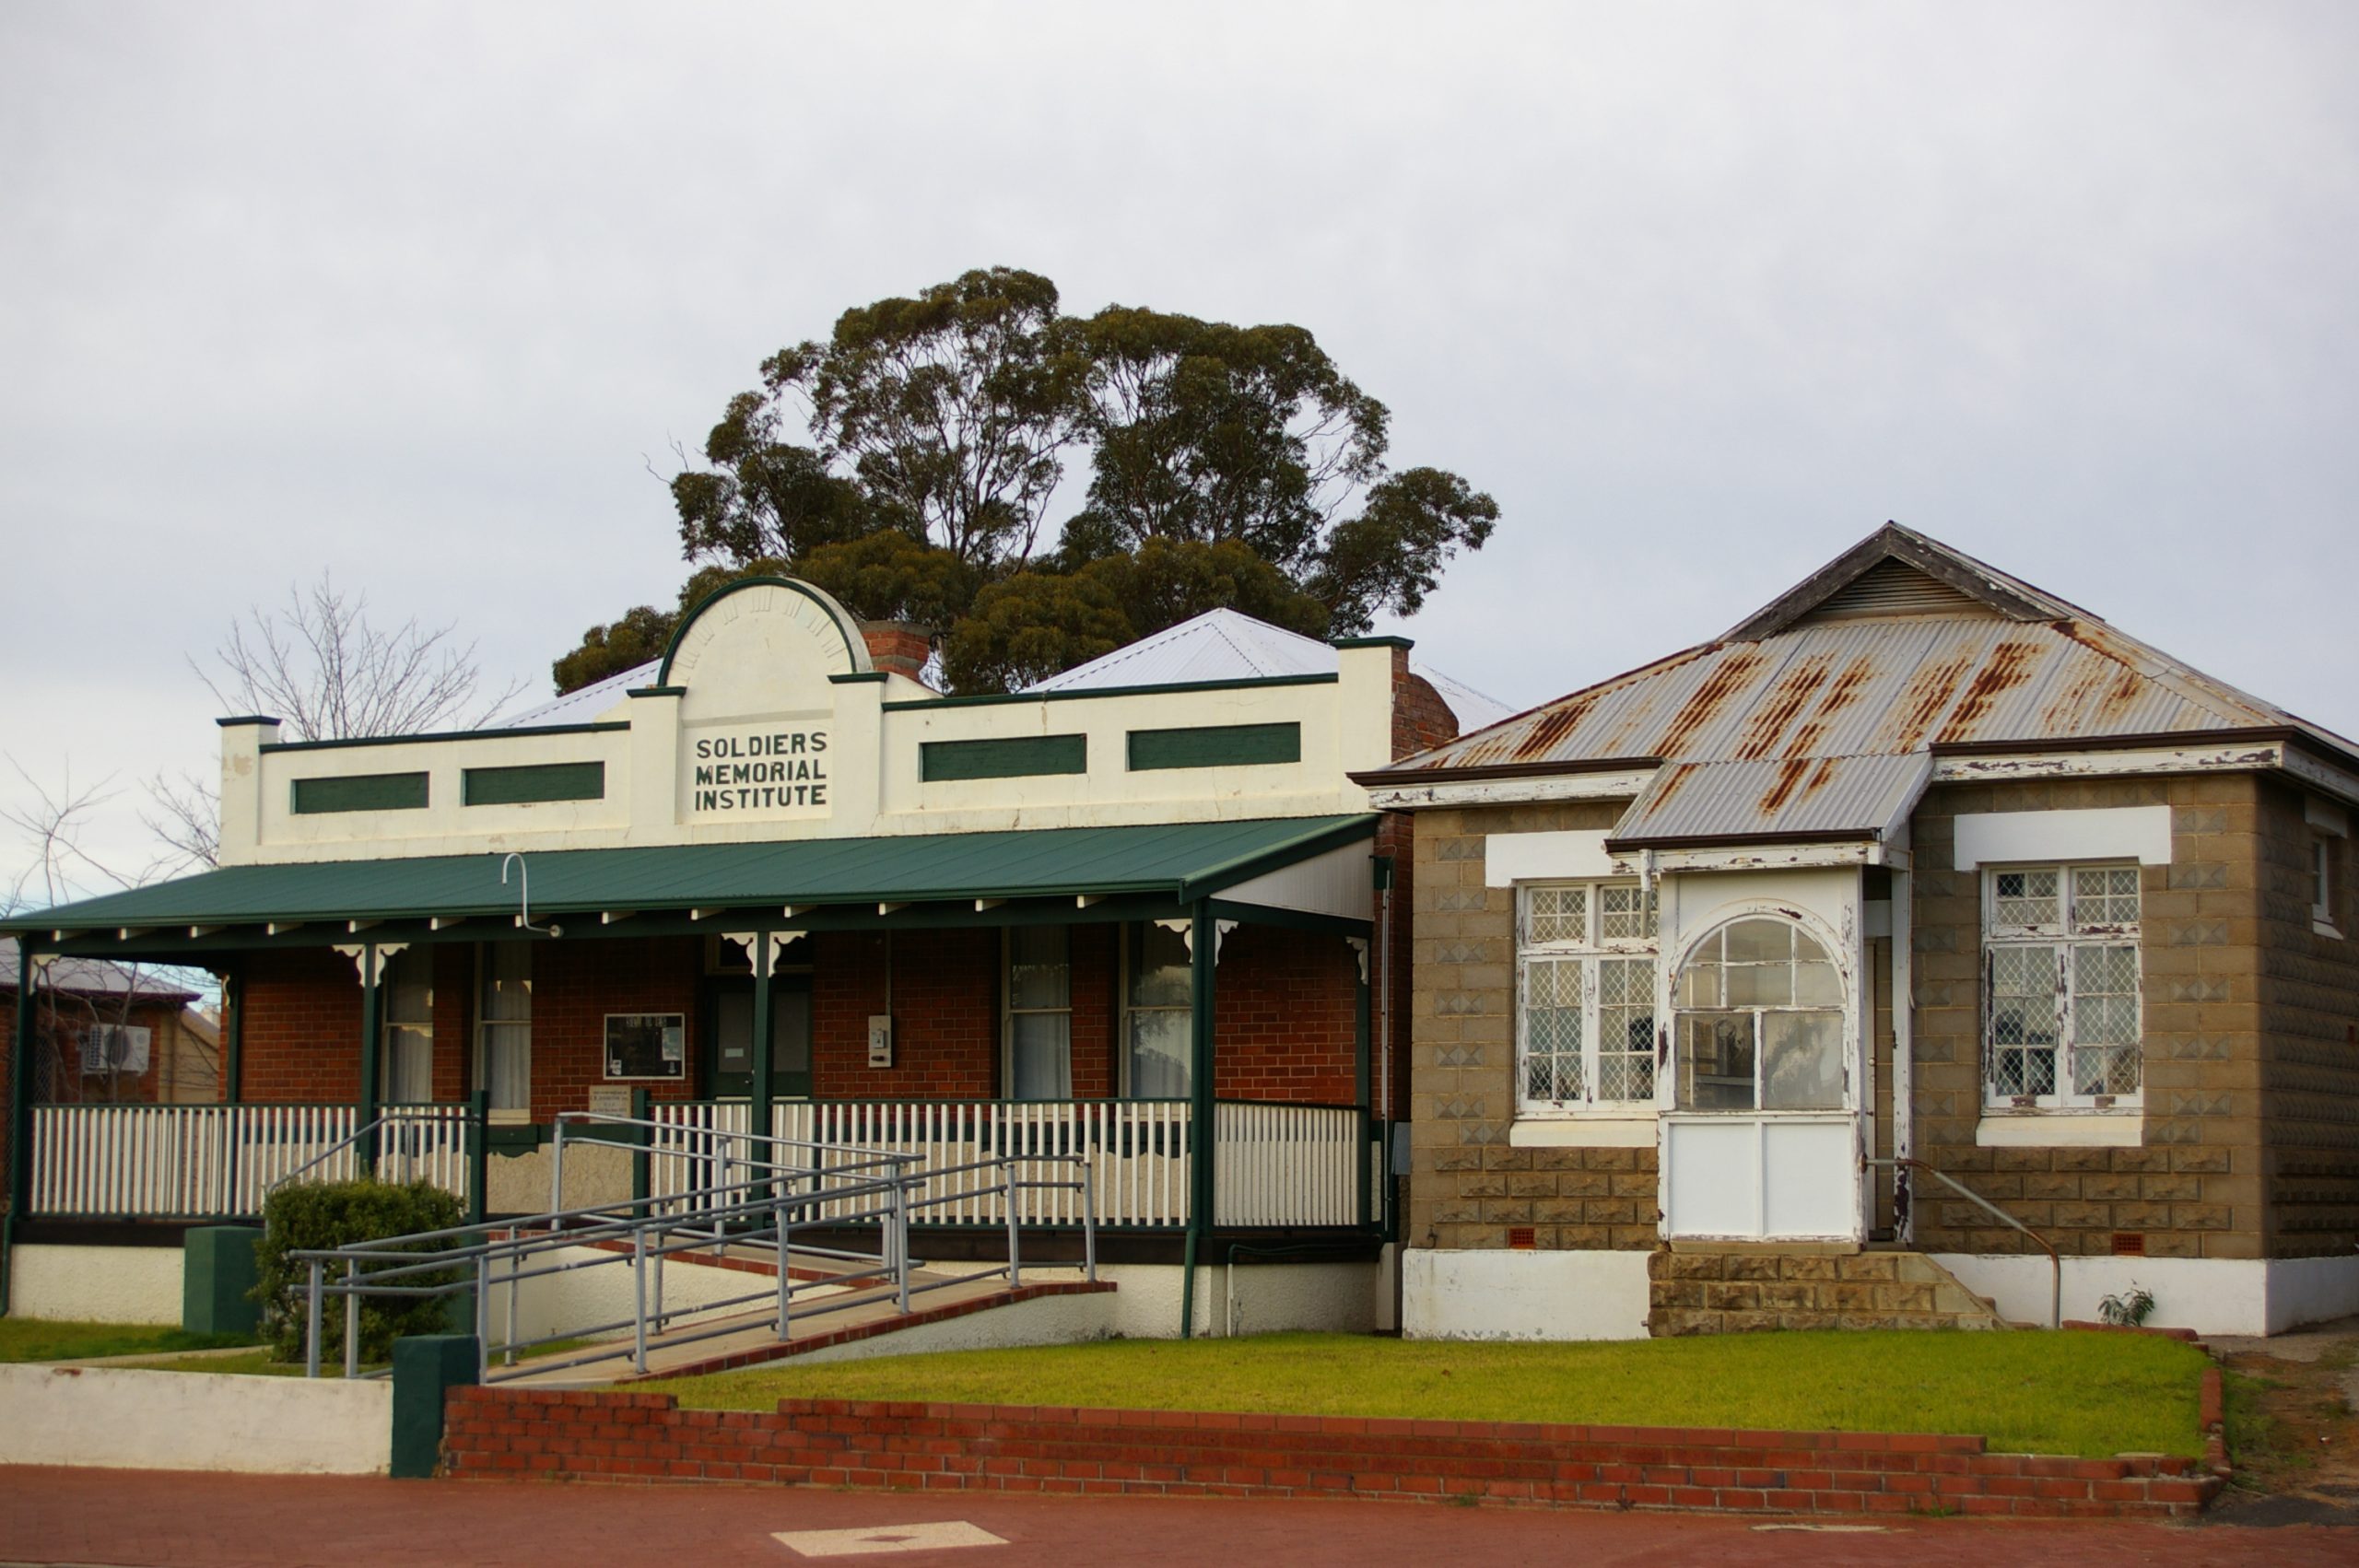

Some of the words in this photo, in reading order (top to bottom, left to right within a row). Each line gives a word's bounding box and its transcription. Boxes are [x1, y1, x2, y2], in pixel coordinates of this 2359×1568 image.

[696, 731, 827, 759] SOLDIERS
[696, 759, 827, 786] MEMORIAL
[695, 784, 827, 812] INSTITUTE
